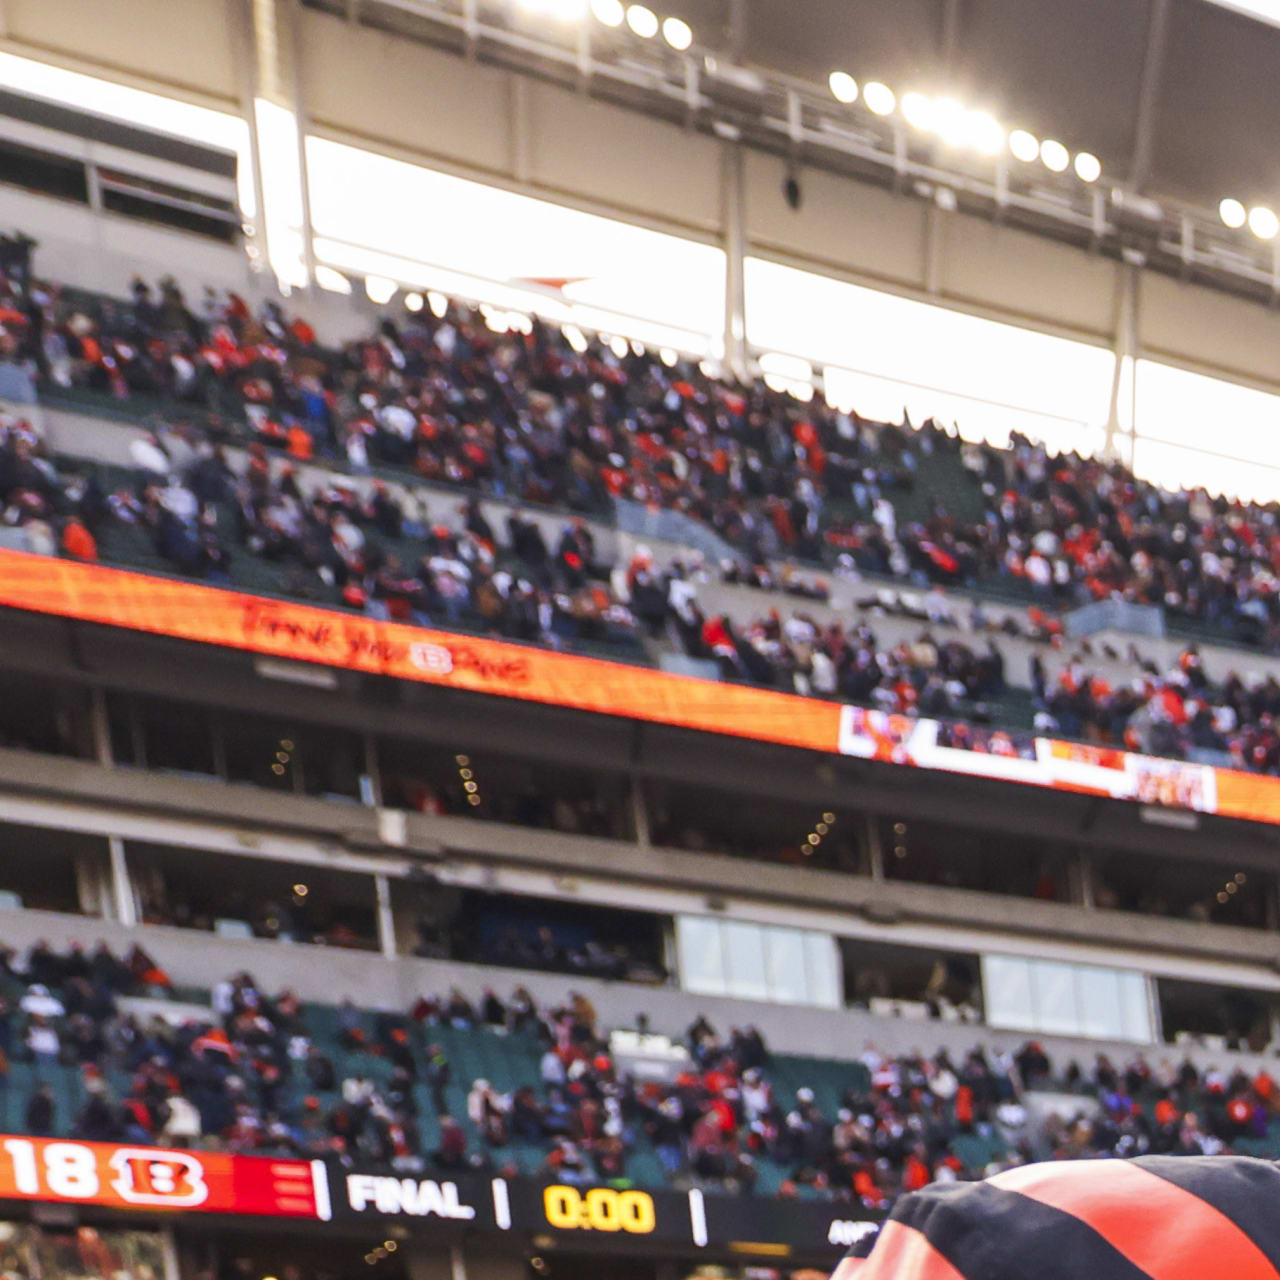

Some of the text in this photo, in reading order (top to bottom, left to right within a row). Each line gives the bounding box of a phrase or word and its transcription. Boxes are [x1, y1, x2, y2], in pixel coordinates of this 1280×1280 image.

[4, 1139, 99, 1198] 18
[346, 1173, 656, 1234] FINAL 0:00
